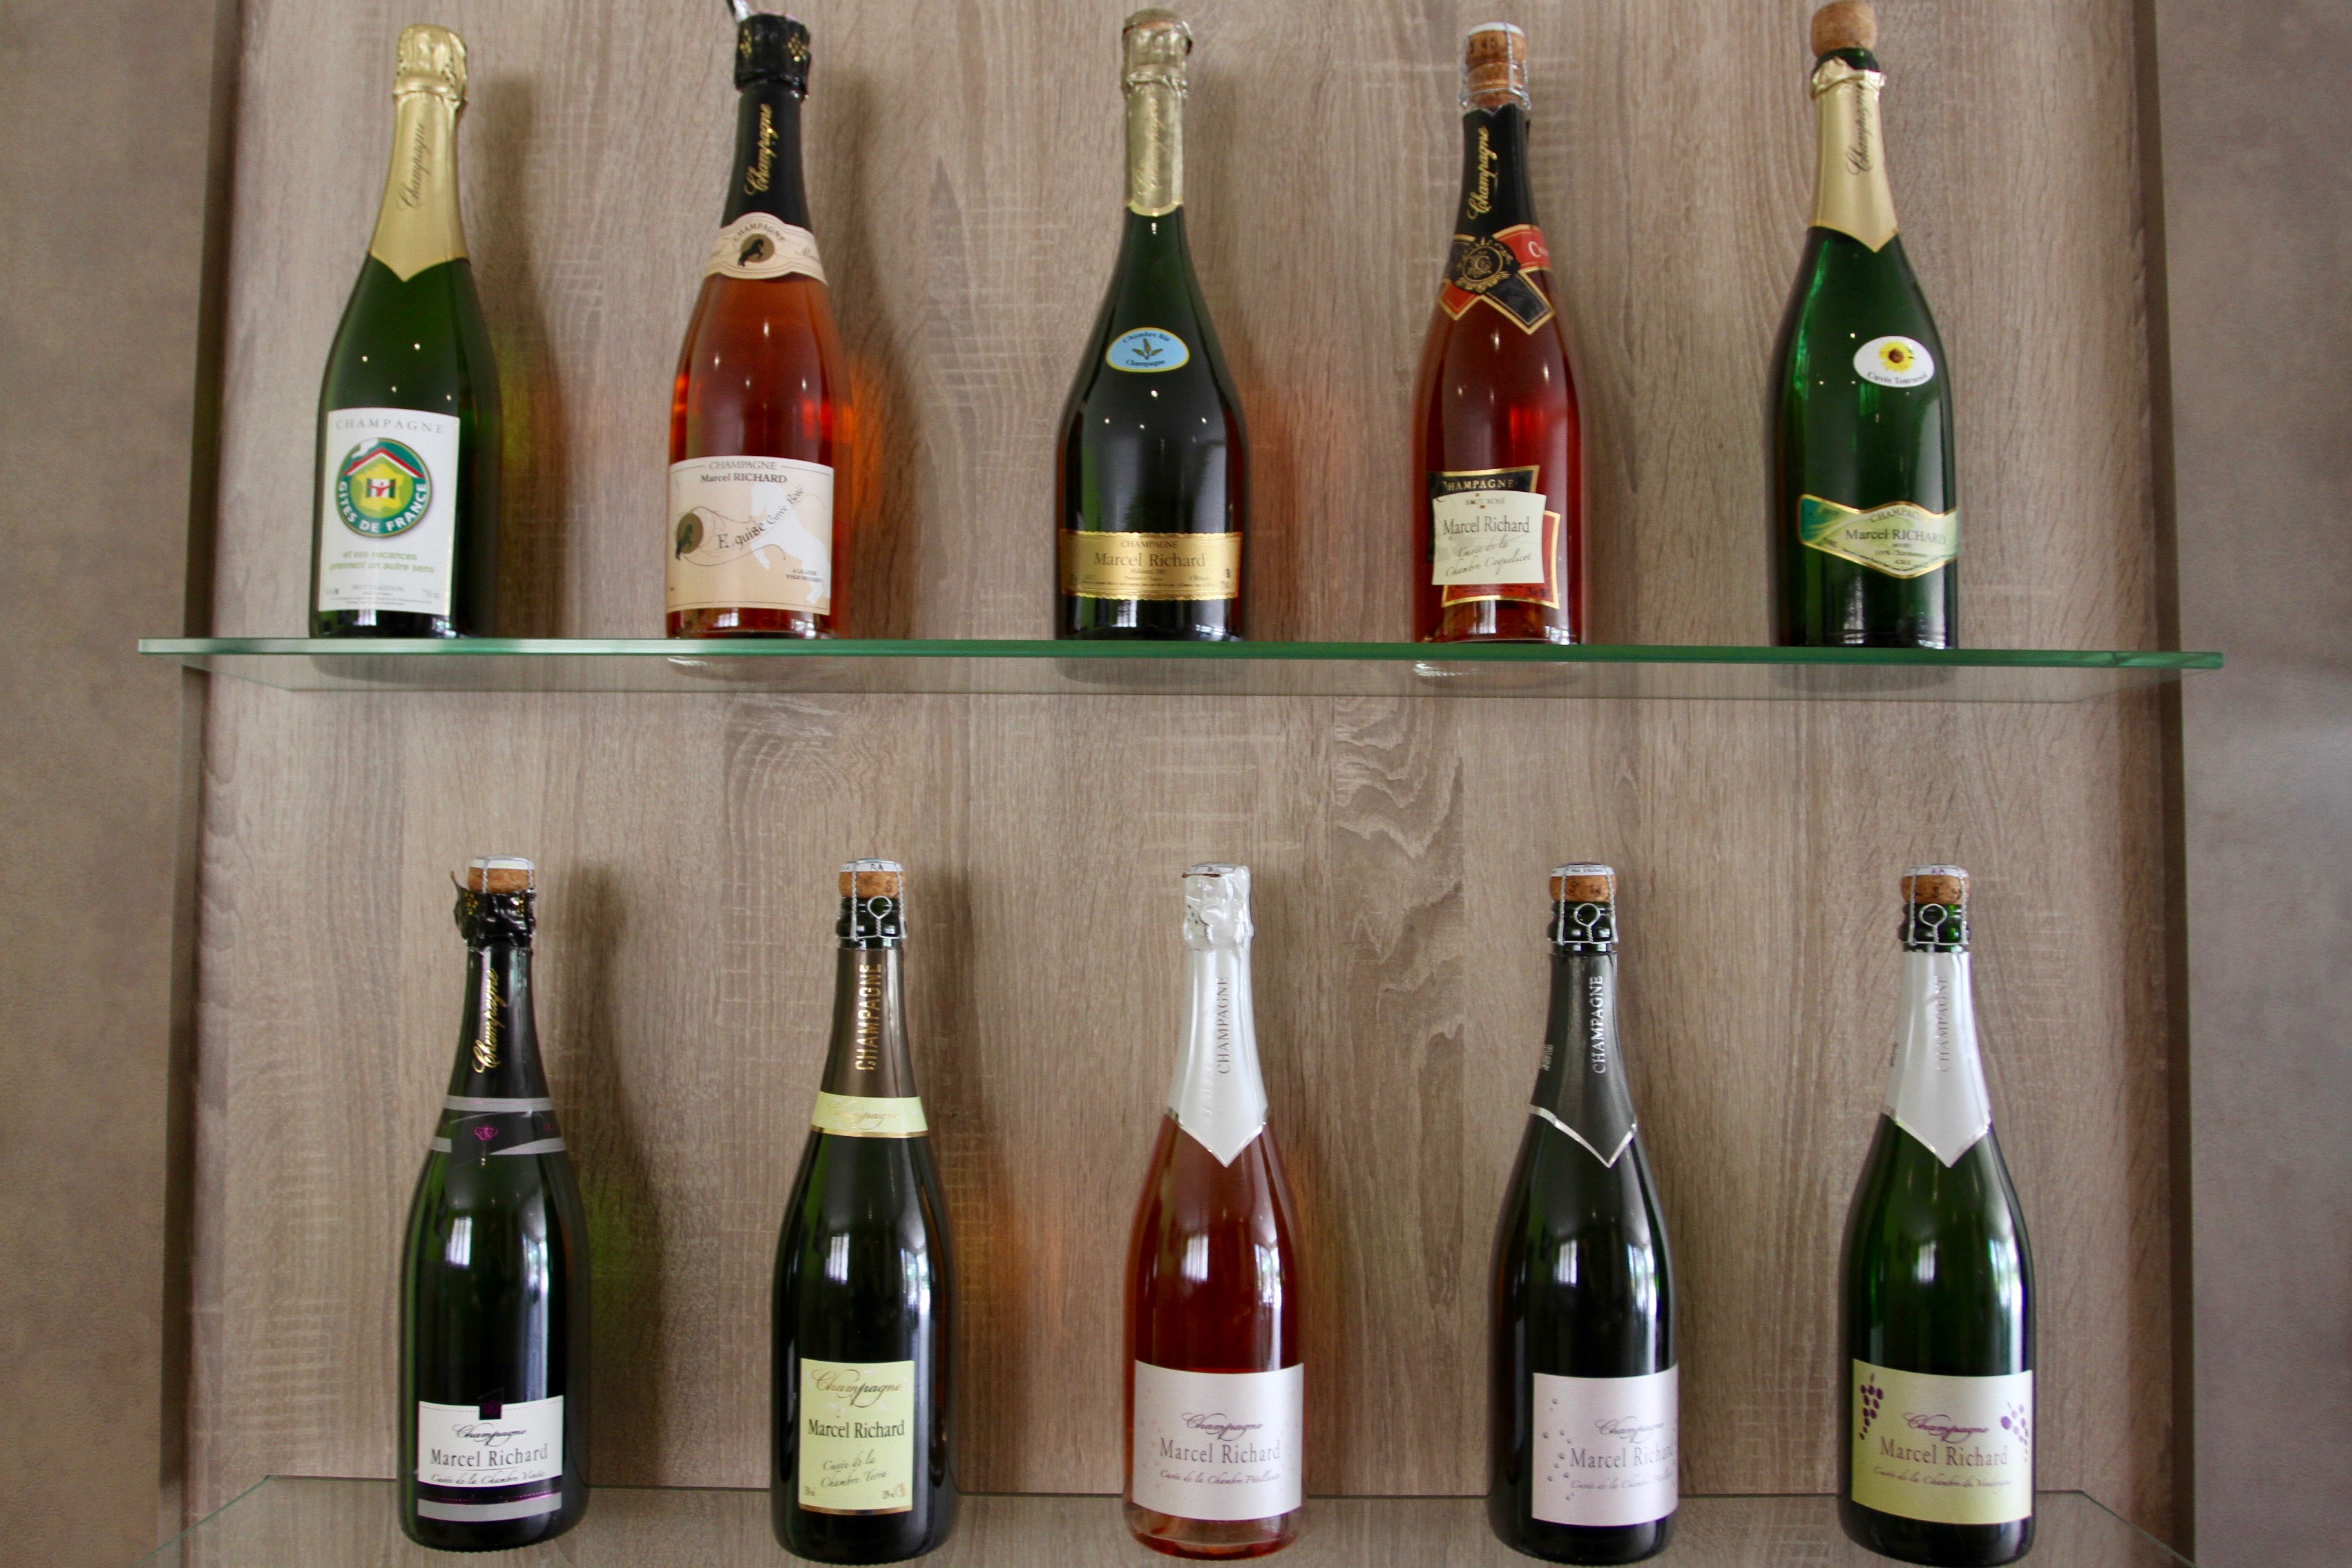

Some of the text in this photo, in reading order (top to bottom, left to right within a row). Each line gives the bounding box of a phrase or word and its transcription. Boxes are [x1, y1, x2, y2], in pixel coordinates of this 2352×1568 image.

[743, 103, 778, 195] Champagne
[396, 122, 432, 210] Champagne
[1466, 125, 1498, 220] Champagne
[734, 222, 786, 242] CHAMPAGNE
[1125, 358, 1166, 367] Champagne
[1867, 371, 1892, 383] Cuvée
[335, 417, 444, 434] CHAMPAGNE
[709, 460, 777, 470] CHAMPAGNE
[700, 472, 787, 484] Marcel RICHARD
[358, 519, 379, 533] DE
[385, 483, 428, 531] FRANCE
[1442, 515, 1531, 535] Marcel Richard
[1845, 528, 1947, 545] Marcel RICHARD
[1120, 540, 1178, 549] CHAMPAGNE
[1093, 552, 1206, 567] Marcel Richard
[1445, 555, 1480, 577] Chambre
[472, 968, 506, 1073] Champagne
[854, 963, 883, 1071] CHAMPAGNE
[1216, 975, 1231, 1075] CHAMPAGNE
[1590, 975, 1604, 1075] CHAMPAGNE
[1934, 975, 1950, 1073] CHAMPAGNE
[812, 1368, 903, 1408] Champagne
[452, 1422, 527, 1447] Champagne
[807, 1418, 905, 1439] Marcel Richard
[1181, 1412, 1263, 1442] Champagne
[1594, 1415, 1665, 1444] Champagne
[1901, 1411, 1989, 1444] Champagne
[430, 1443, 548, 1467] Marcel Richard
[1159, 1437, 1281, 1464] Marcel Richard
[1569, 1447, 1626, 1469] Marcel
[1880, 1436, 2009, 1466] Marcel Richard
[431, 1473, 453, 1484] Cuvée
[455, 1473, 467, 1484] de
[467, 1472, 478, 1484] la
[481, 1471, 519, 1484] Chambre
[820, 1469, 860, 1489] Chambre
[1195, 1472, 1205, 1483] la
[1207, 1471, 1243, 1484] Chambre
